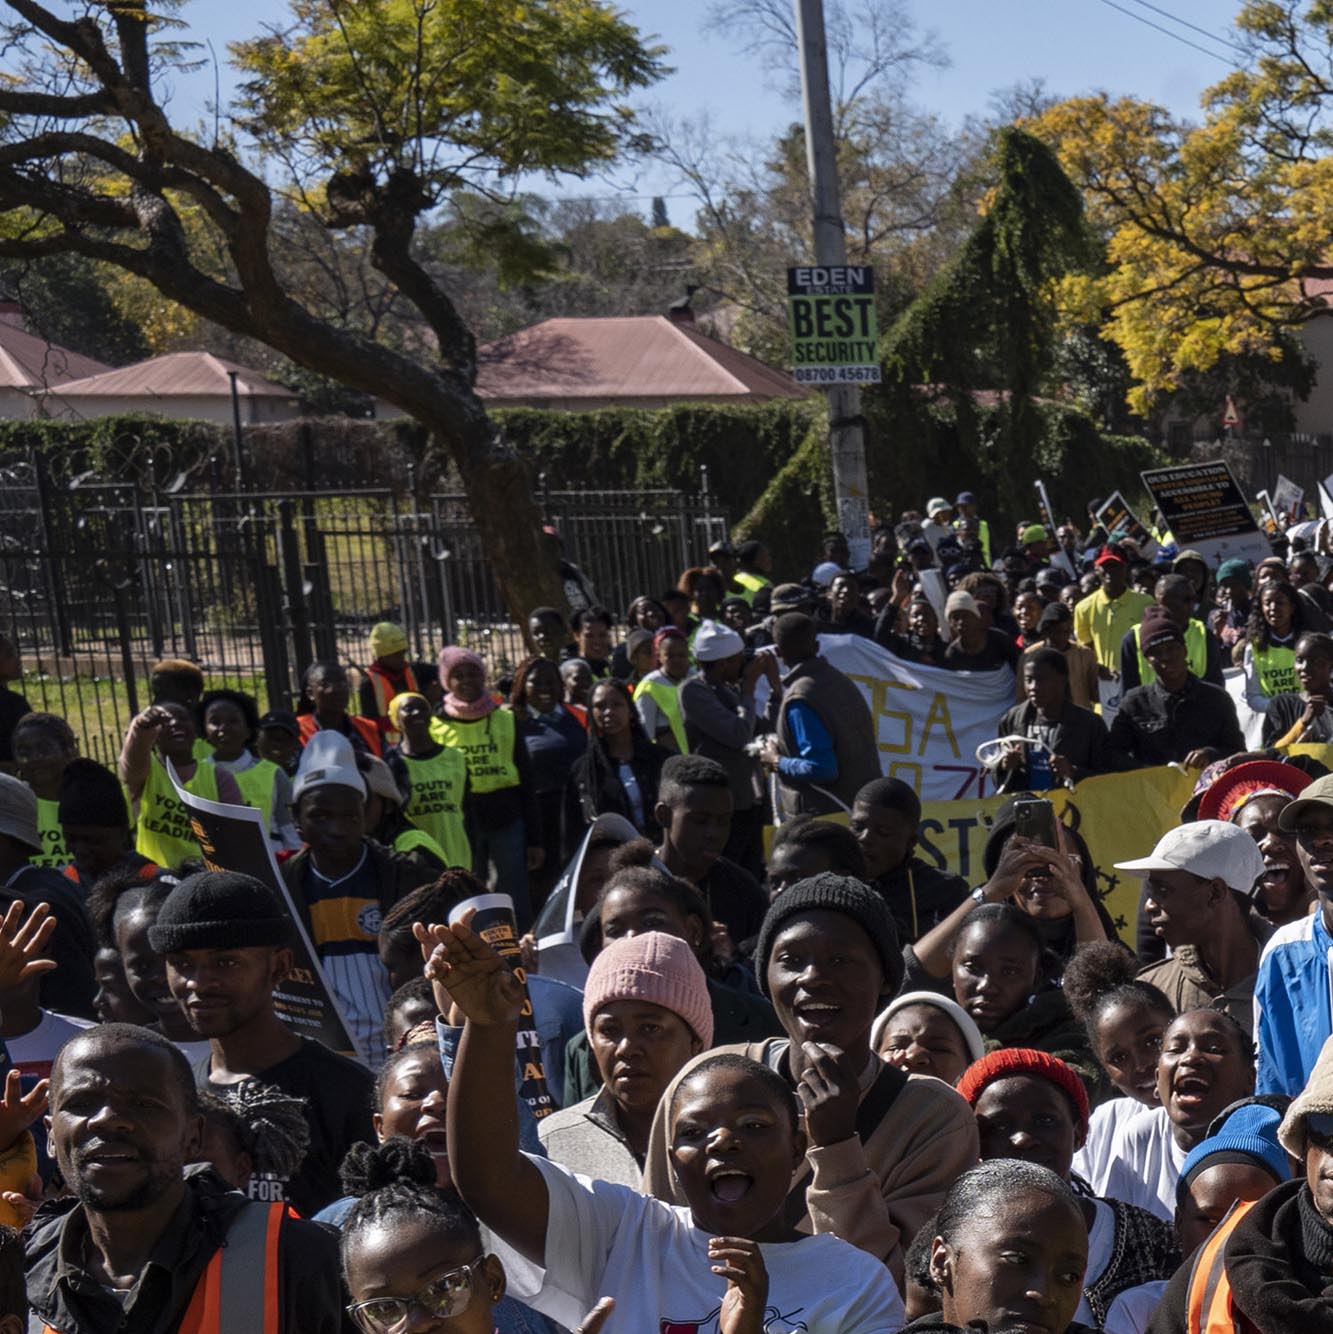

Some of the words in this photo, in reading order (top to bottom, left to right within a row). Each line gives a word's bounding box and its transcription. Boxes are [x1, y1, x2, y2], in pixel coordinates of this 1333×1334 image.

[795, 268, 865, 286] EDEN
[793, 298, 872, 338] BEST
[794, 341, 877, 362] SECURITY
[456, 743, 498, 754] OUTH
[420, 790, 447, 803] ARE
